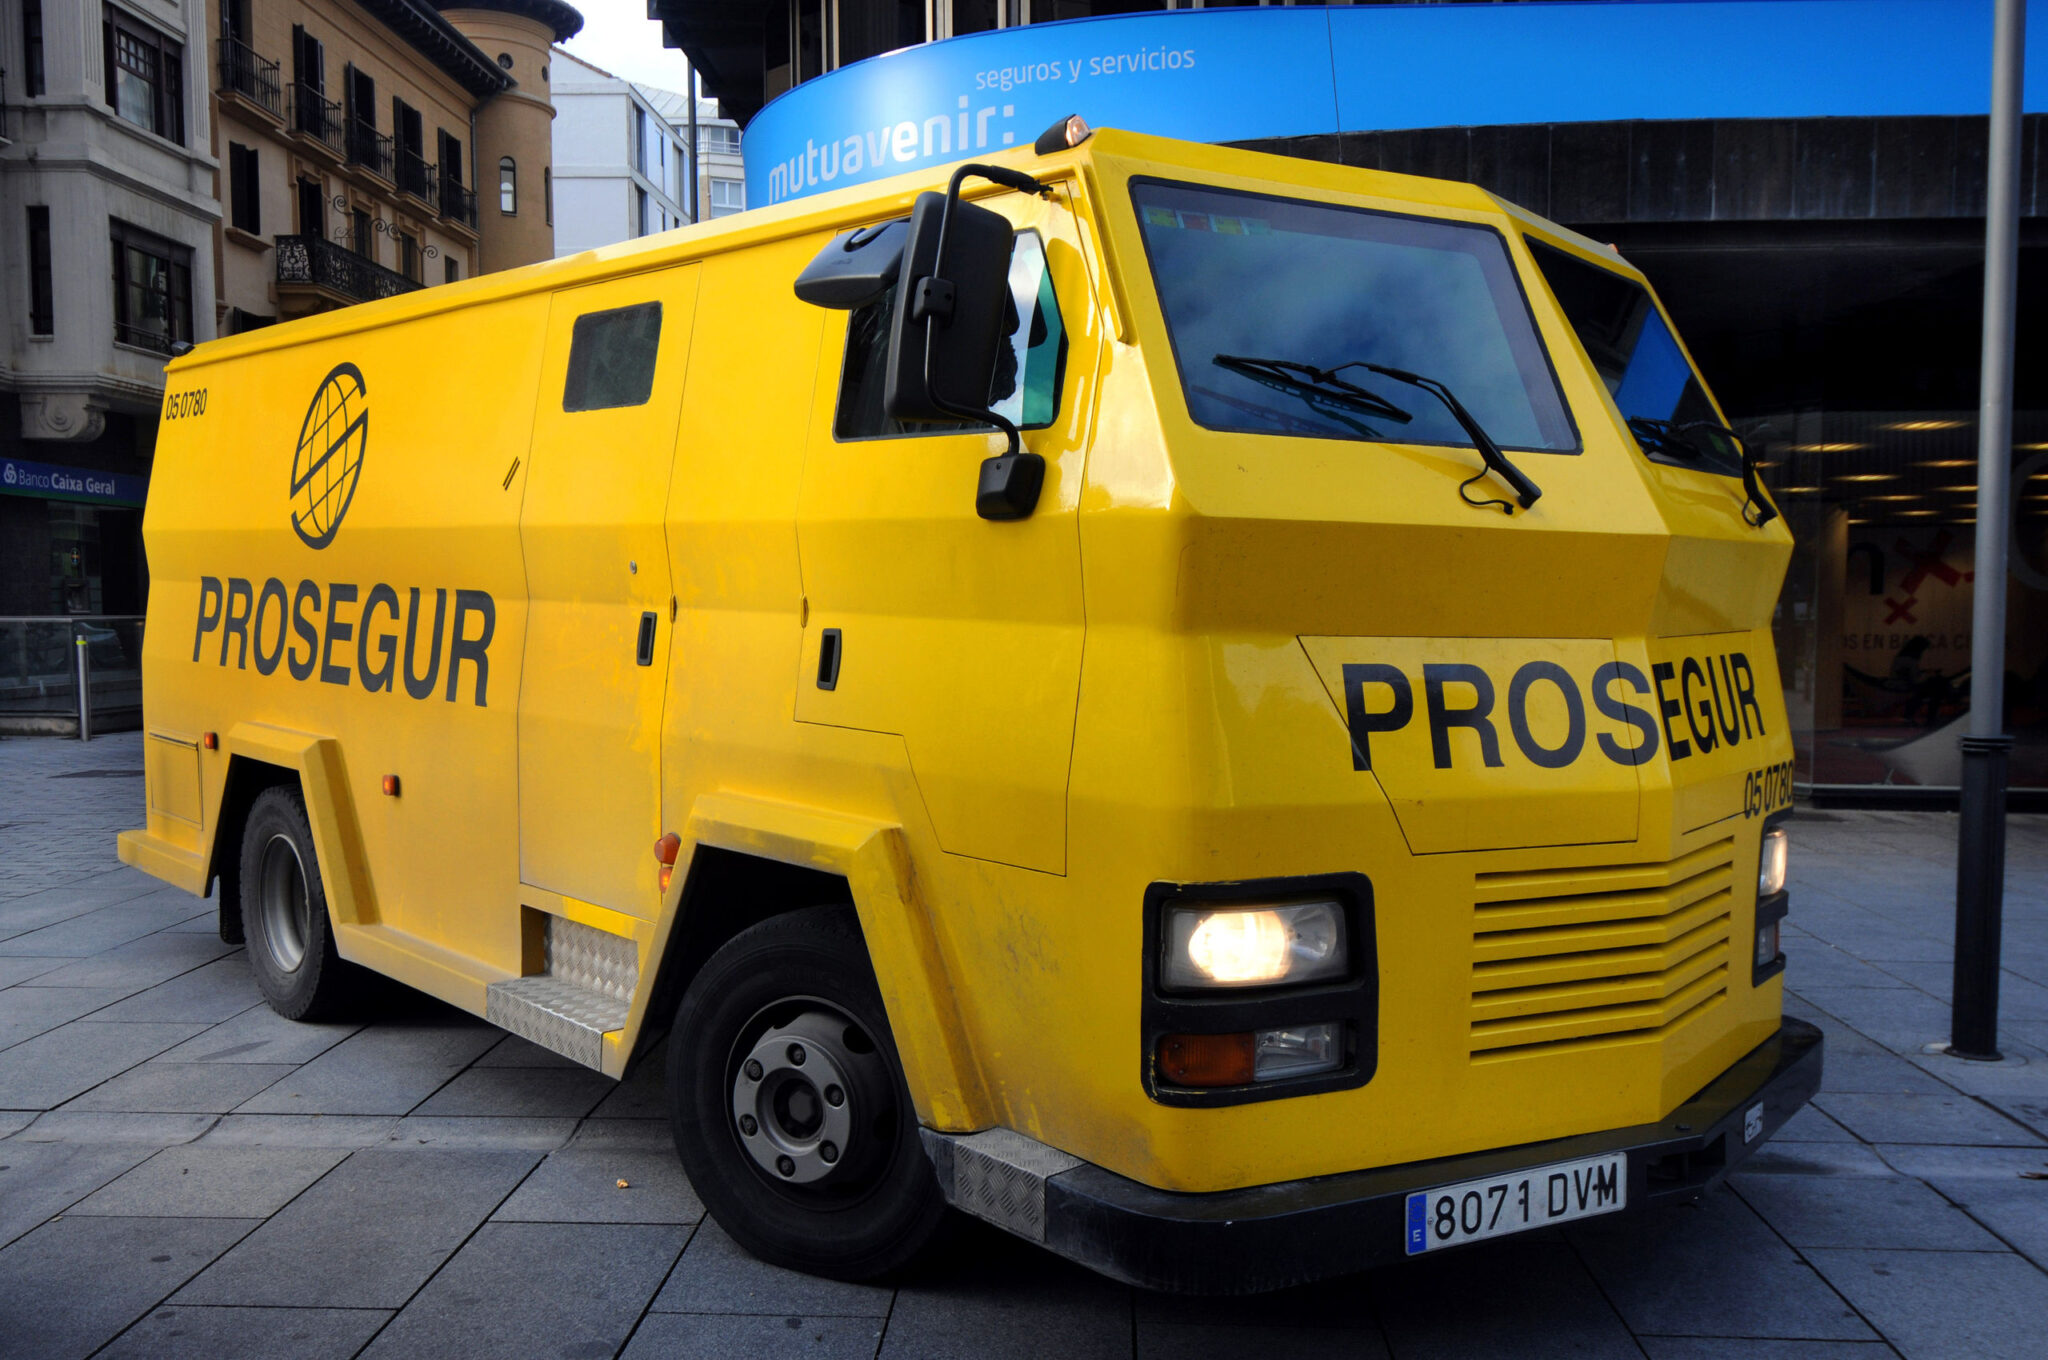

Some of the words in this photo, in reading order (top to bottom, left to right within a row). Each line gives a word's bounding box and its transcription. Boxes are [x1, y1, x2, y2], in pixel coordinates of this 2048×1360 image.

[976, 59, 1061, 92] seguros
[1068, 58, 1082, 83] y
[1089, 46, 1196, 76] servicios
[19, 469, 49, 488] Banco
[51, 473, 83, 491] Caixa
[86, 477, 115, 496] Geral
[192, 576, 496, 708] PROSEGUR
[1341, 652, 1766, 772] PROSEGUR
[1435, 1179, 1531, 1240] 8071
[1548, 1162, 1618, 1218] DVM
[1412, 1229, 1422, 1242] E
